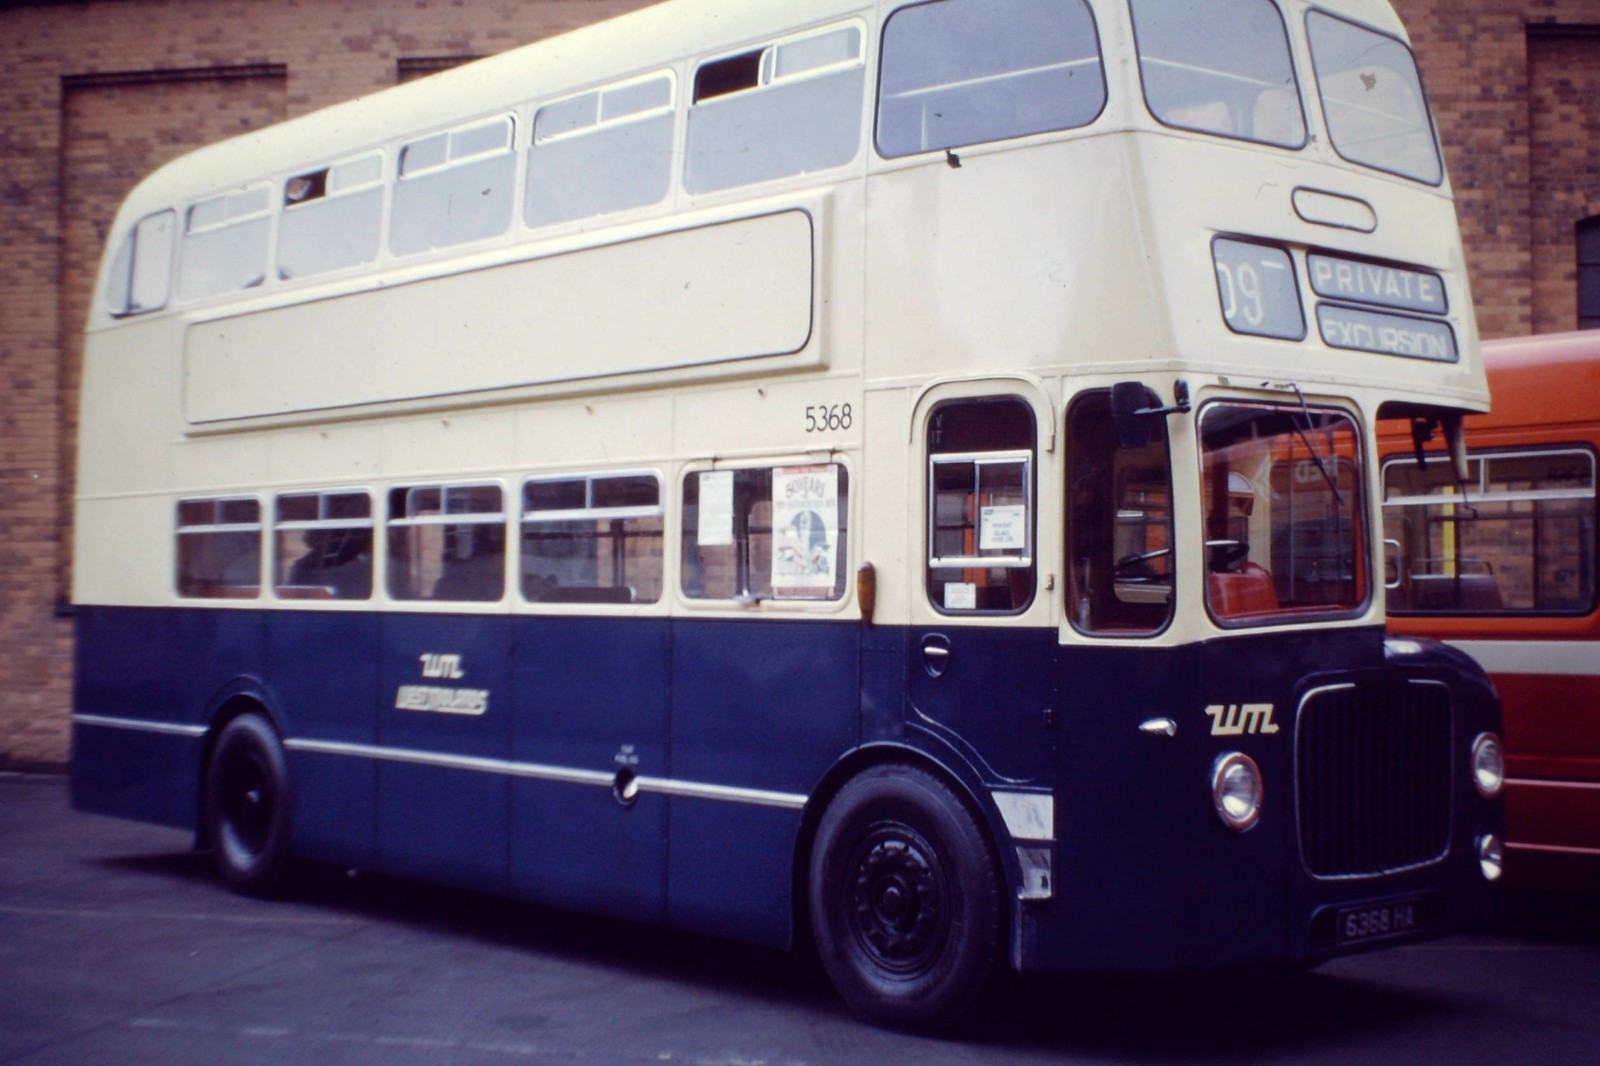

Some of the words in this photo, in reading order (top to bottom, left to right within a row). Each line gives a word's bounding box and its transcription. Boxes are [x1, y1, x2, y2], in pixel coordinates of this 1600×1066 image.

[1314, 260, 1436, 303] PRIVATE
[1322, 318, 1450, 358] EXCURSION
[805, 402, 852, 432] 5368
